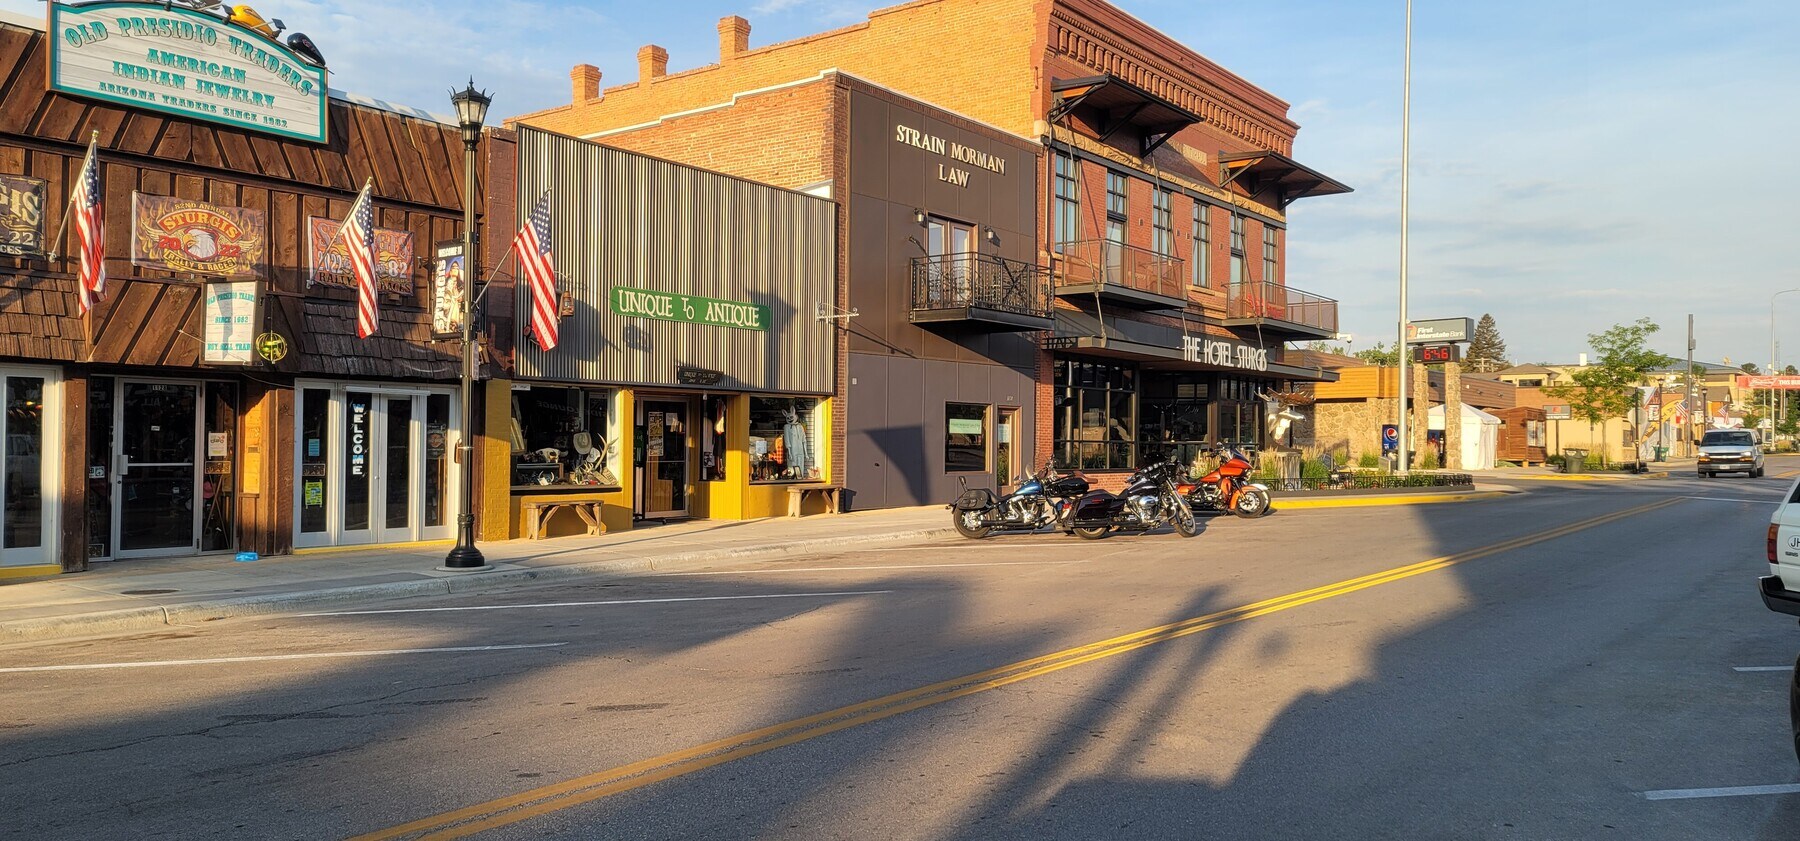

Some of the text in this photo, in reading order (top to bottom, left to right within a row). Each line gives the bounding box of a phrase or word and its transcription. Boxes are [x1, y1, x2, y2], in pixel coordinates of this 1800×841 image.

[65, 17, 314, 97] OLD PRESIDIO TRADERS
[146, 48, 247, 84] AMERICAN
[113, 61, 275, 109] INDIAN JEWELRY
[98, 81, 288, 128] ARIZONA TRADERS SINCE 1982
[896, 124, 1006, 174] STRAIN MORMAN
[938, 164, 970, 188] LAW
[163, 211, 239, 239] STURGIS
[199, 203, 231, 219] ANNUAL
[168, 253, 194, 268] RALLY
[207, 259, 234, 271] RACES
[318, 250, 408, 279] 2022 82
[435, 259, 447, 330] STURGIS
[618, 289, 674, 317] UNIQUE
[705, 302, 760, 327] ANTIQUE
[1416, 330, 1465, 339] Interstate Bank
[1182, 335, 1268, 372] THE HOTEL STURGIS
[352, 403, 366, 475] WELCOME
